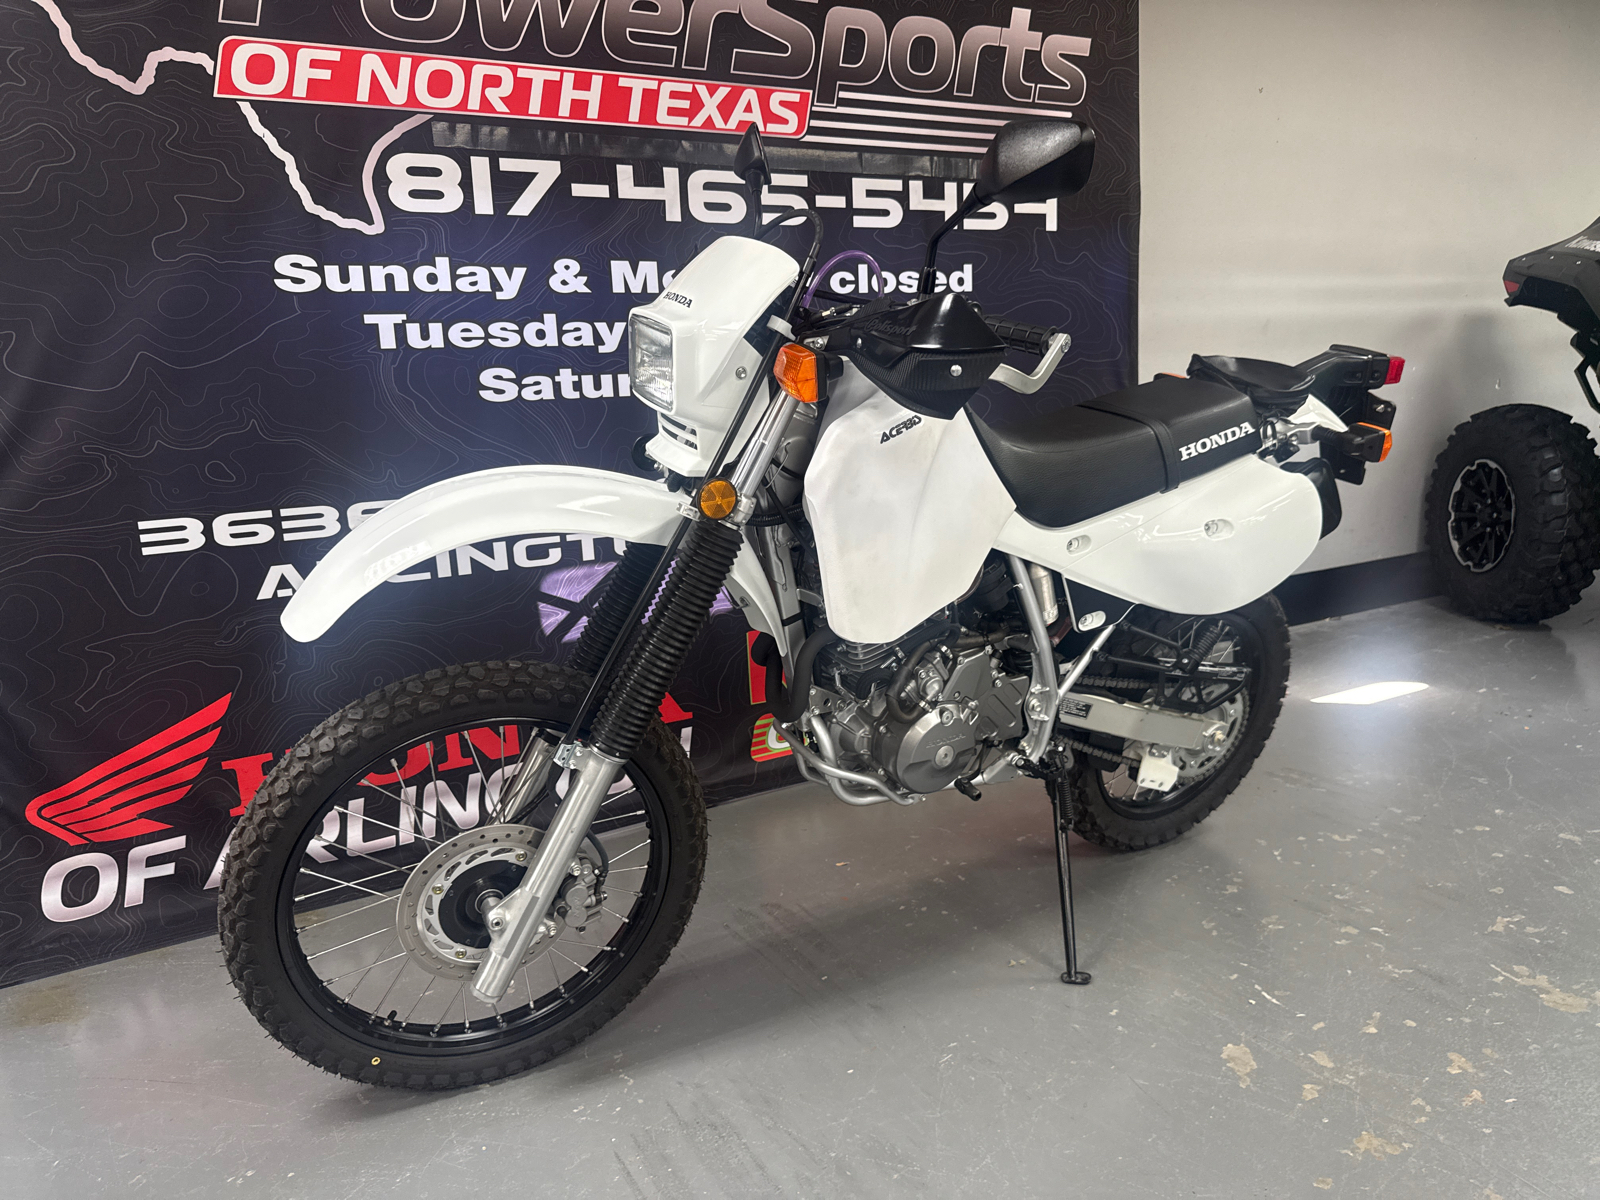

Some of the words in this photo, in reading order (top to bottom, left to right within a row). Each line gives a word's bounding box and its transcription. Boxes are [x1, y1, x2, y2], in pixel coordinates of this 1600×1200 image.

[217, 0, 1092, 108] owerSports
[230, 42, 341, 98] OF
[356, 53, 604, 120] NORTH
[617, 77, 802, 136] TEXAS
[273, 254, 526, 300] Sunday
[548, 258, 590, 294] &
[662, 291, 693, 309] HONDA
[363, 313, 627, 354] Tuesday
[1178, 421, 1257, 461] HONDA
[40, 834, 187, 923] OF
